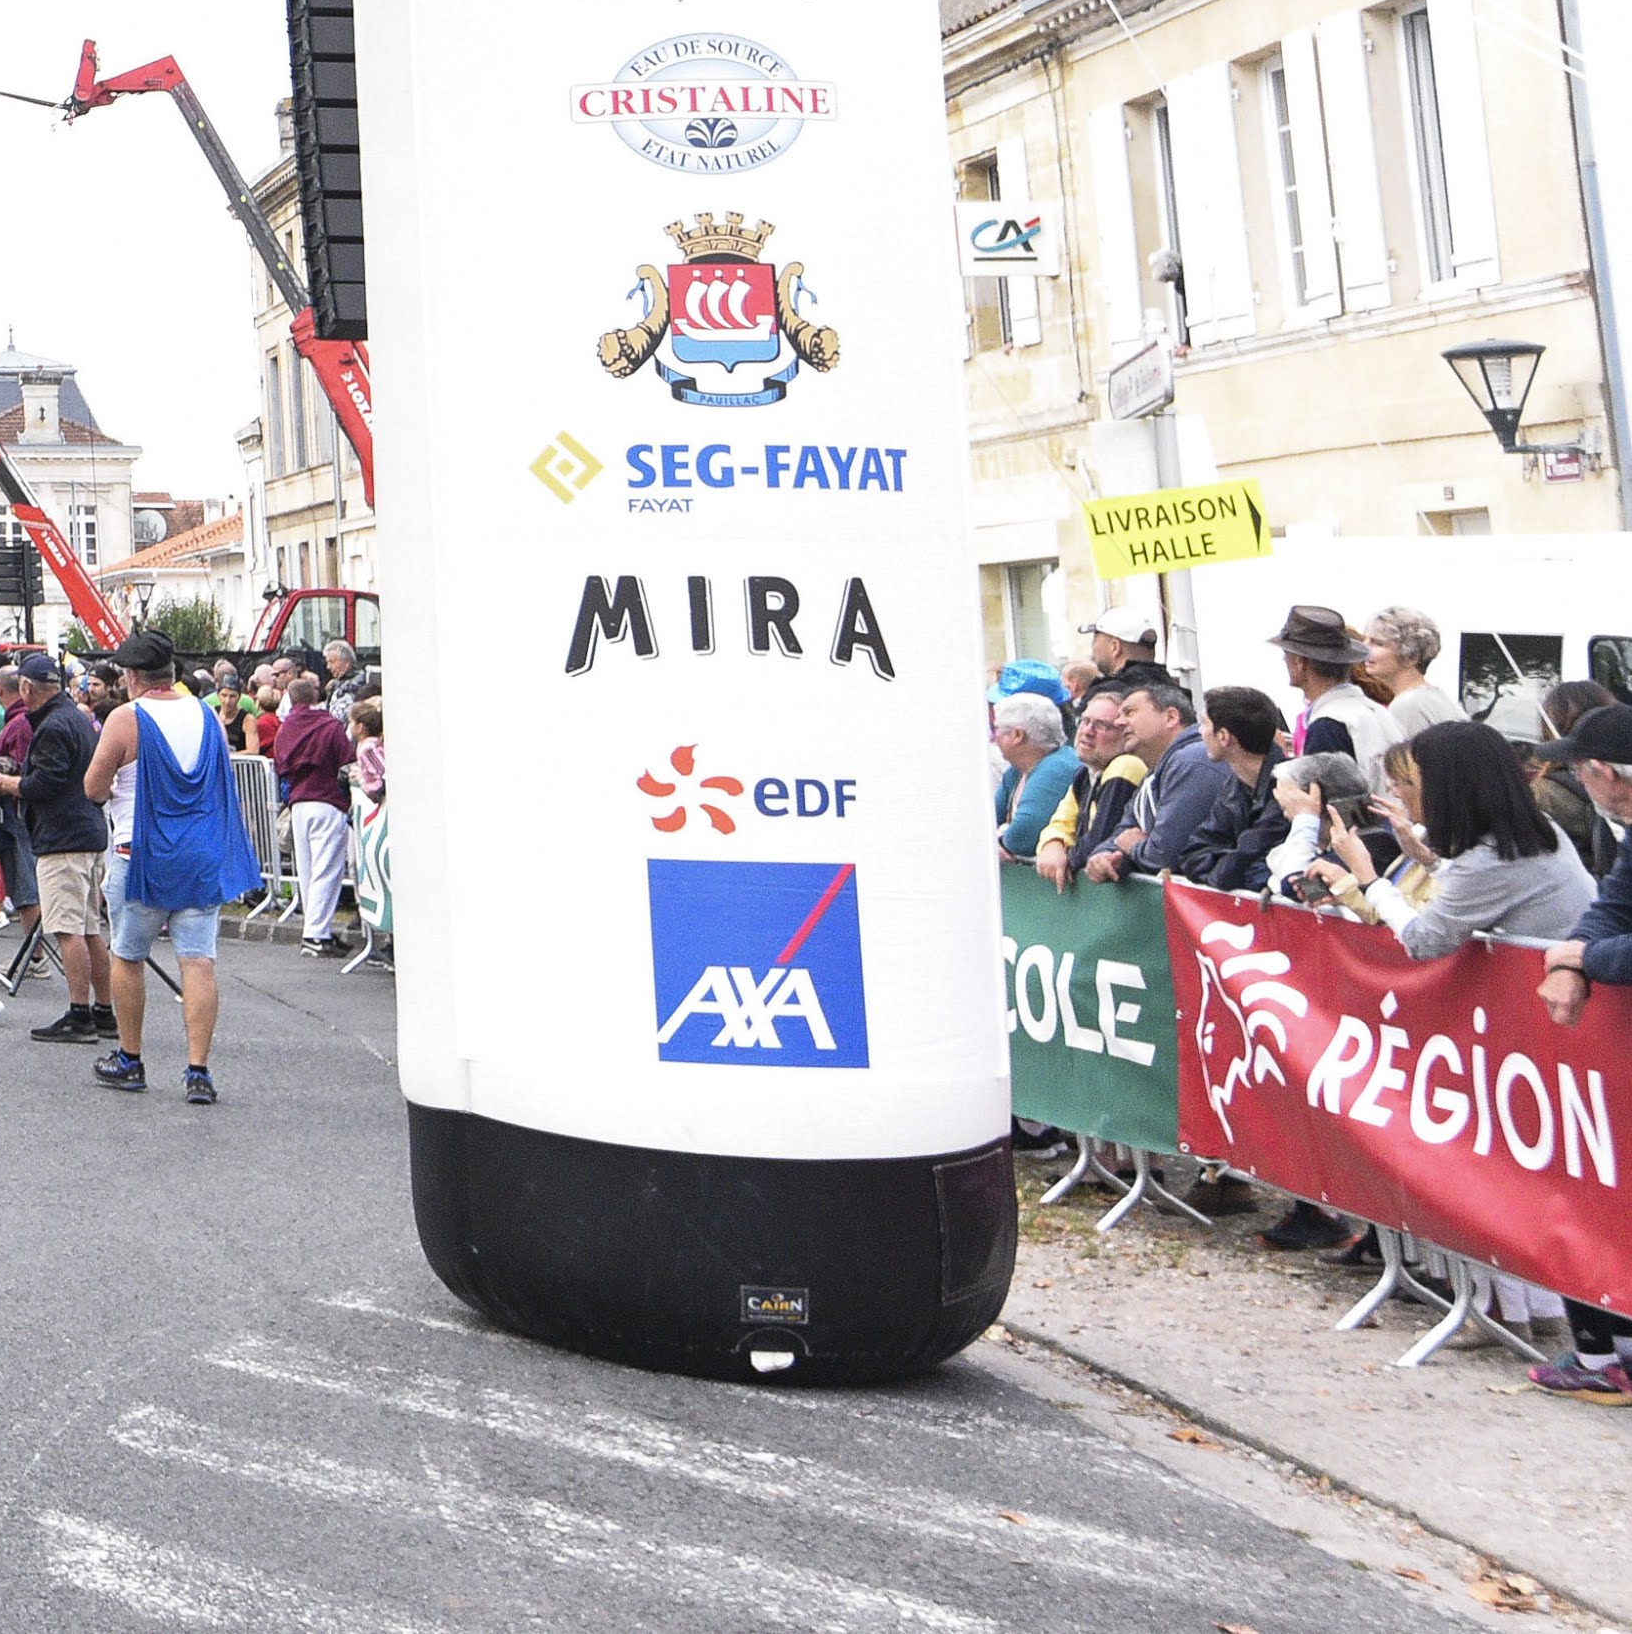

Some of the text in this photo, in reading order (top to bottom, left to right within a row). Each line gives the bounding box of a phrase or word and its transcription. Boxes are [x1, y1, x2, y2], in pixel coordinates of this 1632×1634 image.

[630, 39, 784, 78] EAU DE SOURCE
[578, 85, 831, 119] CRISTALINE
[640, 138, 782, 171] ETAT NATUREL
[698, 392, 762, 406] PAUILLAC
[625, 443, 907, 493] SEG-FAYAT
[628, 498, 695, 514] FAYAT
[1090, 492, 1240, 539] LIVRAISON
[1129, 531, 1218, 569] HALLE
[564, 575, 896, 682] MIRA
[657, 966, 837, 1050] AXA
